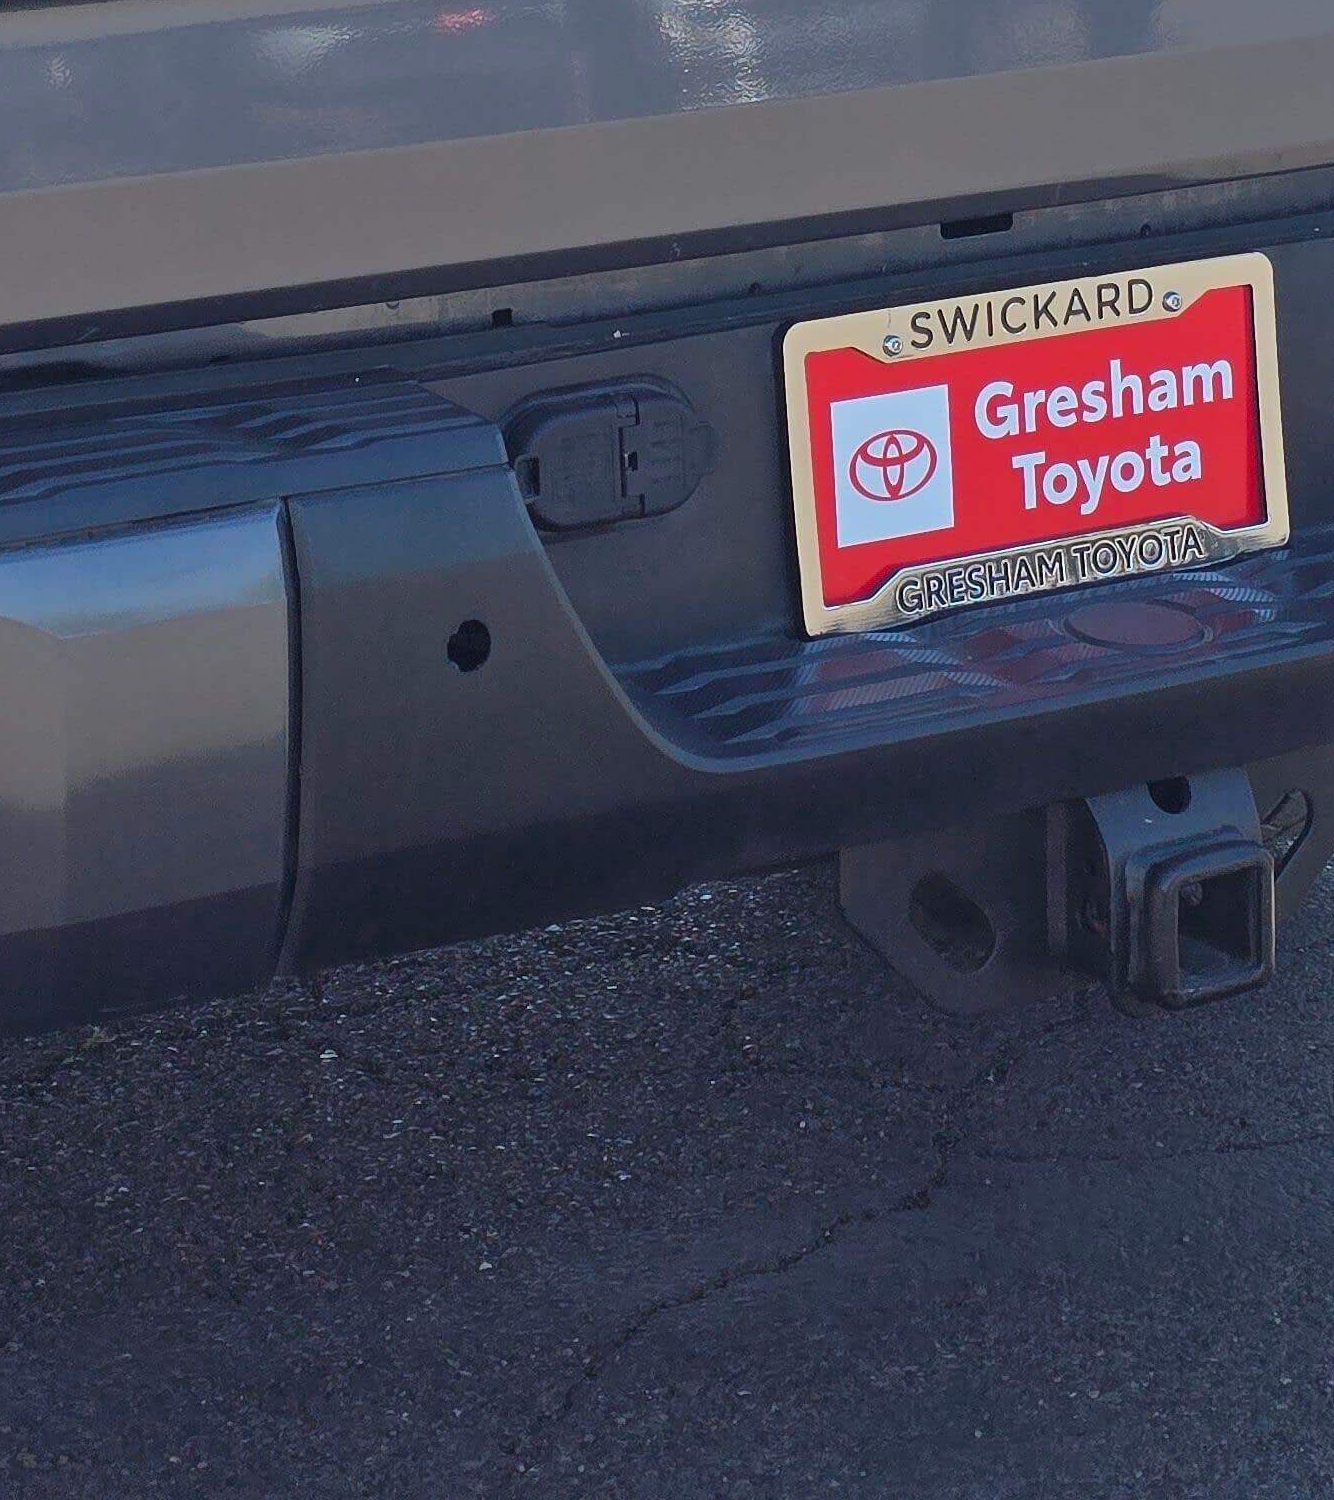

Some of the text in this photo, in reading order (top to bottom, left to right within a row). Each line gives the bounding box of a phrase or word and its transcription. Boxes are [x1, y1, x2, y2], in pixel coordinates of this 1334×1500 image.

[910, 278, 1154, 350] SWICKARD
[974, 358, 1234, 440] Gresham
[1012, 434, 1202, 515] Toyota
[896, 525, 1207, 615] GRESHAM TOYOTA
